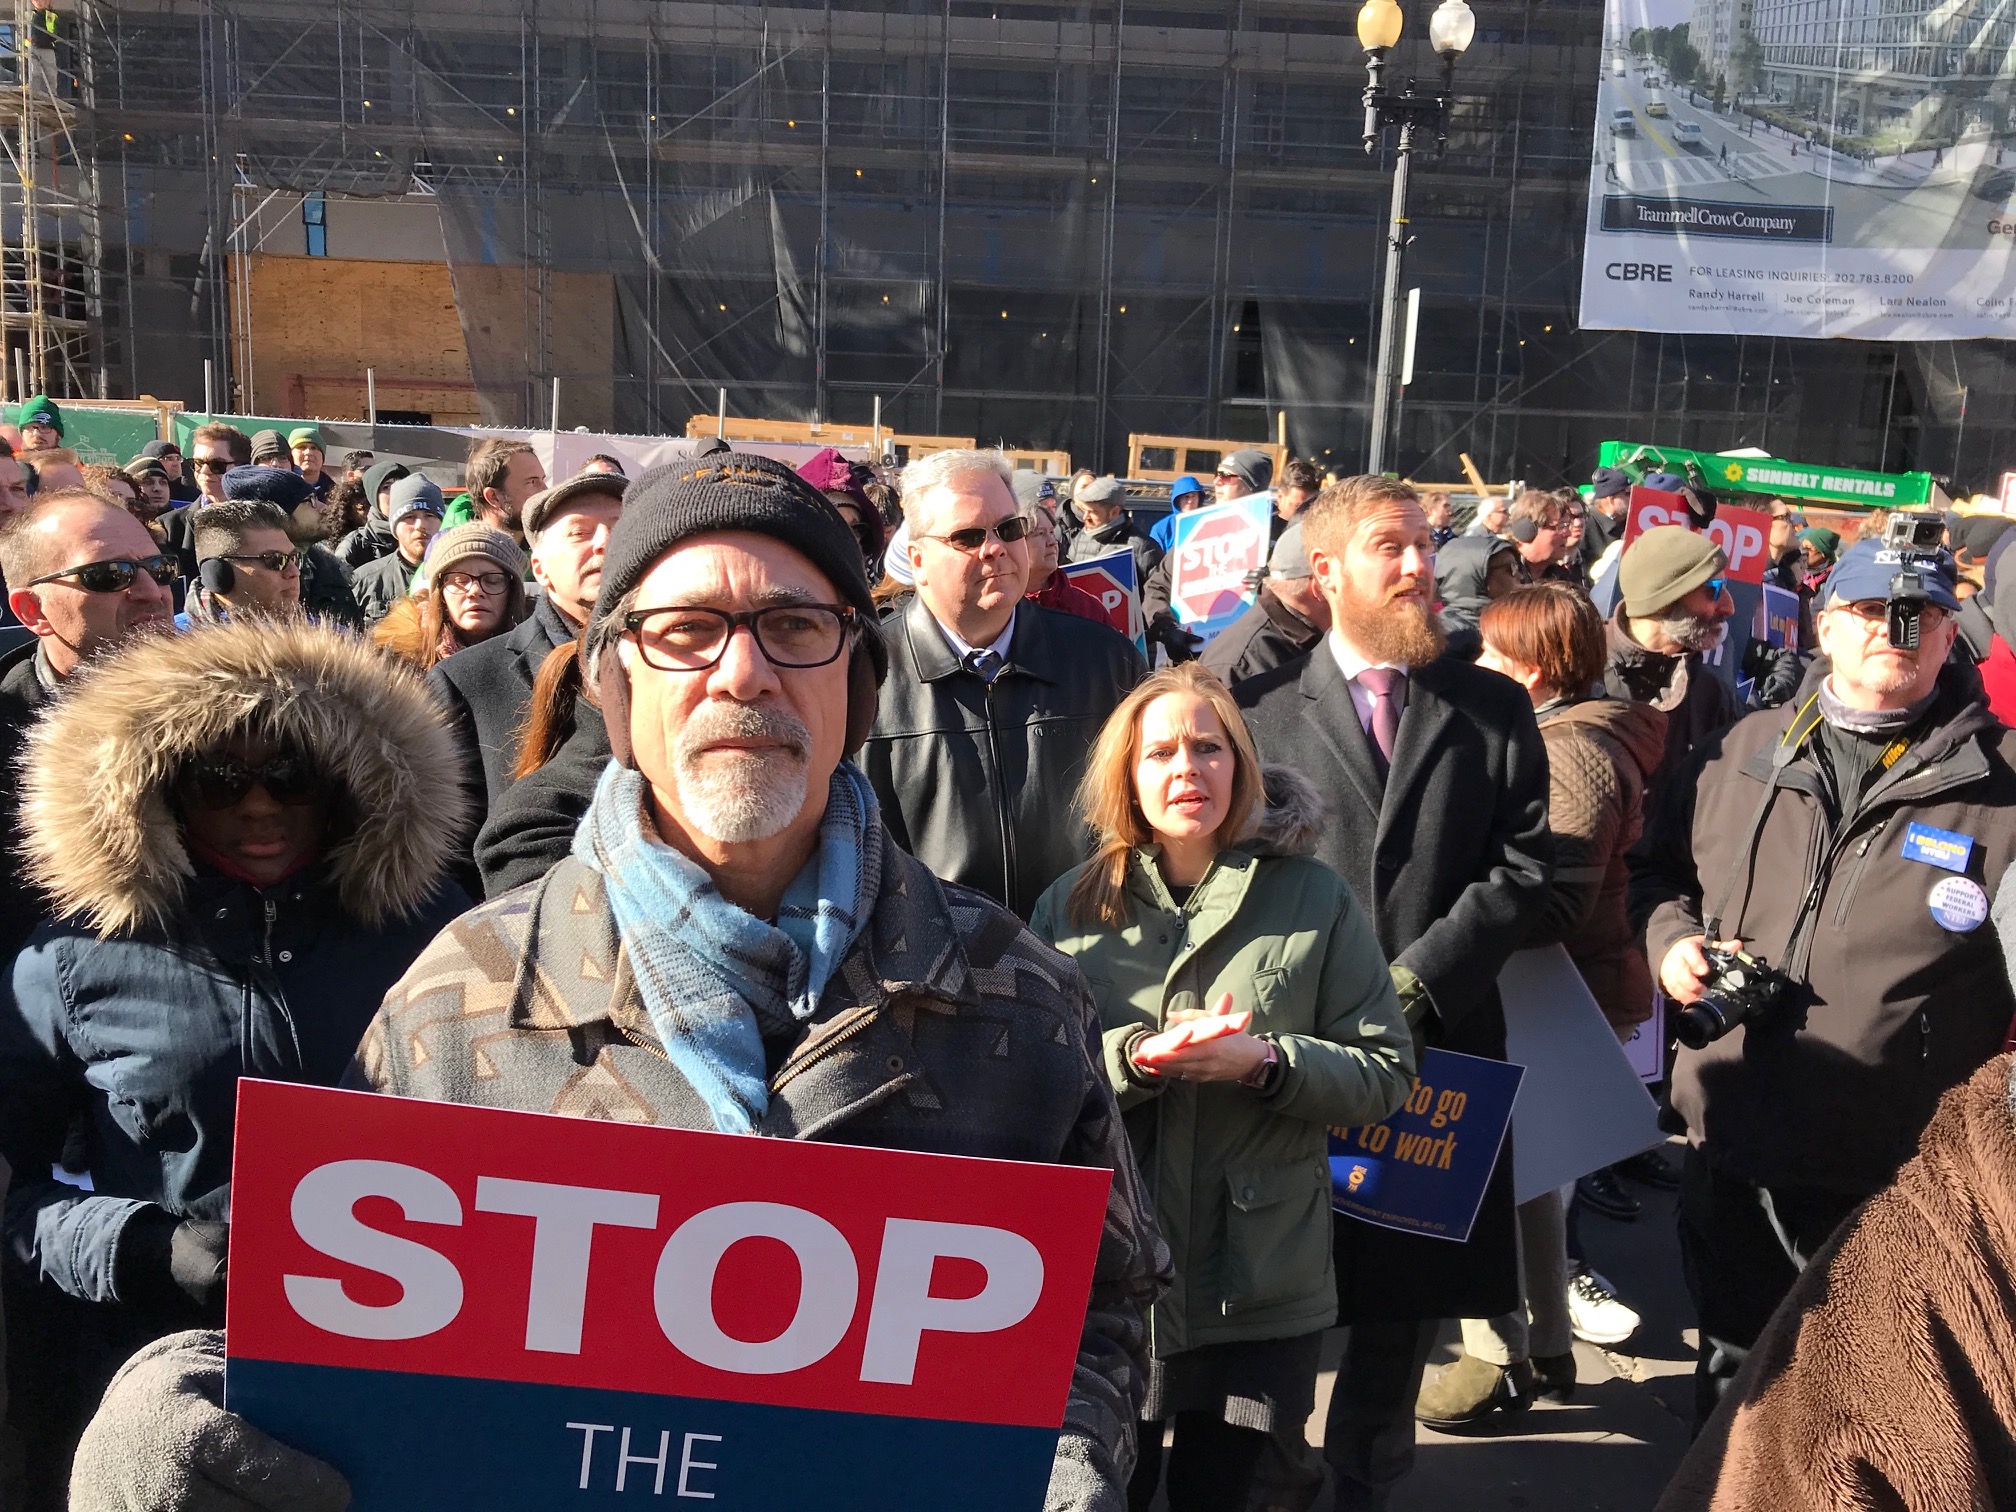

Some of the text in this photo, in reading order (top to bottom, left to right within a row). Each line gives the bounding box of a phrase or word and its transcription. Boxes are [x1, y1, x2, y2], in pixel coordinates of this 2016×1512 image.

[1987, 219, 2016, 236] Ge
[1605, 262, 1673, 282] CBRE
[1689, 266, 1712, 277] FOR
[1716, 267, 1764, 280] LEASING
[1834, 273, 1914, 284] 202.783.8200
[1689, 288, 1765, 302] Randy Harrell
[1784, 293, 1803, 303] Joe
[1906, 297, 1947, 307] Nealon
[1976, 297, 2005, 307] Colin
[1746, 467, 1896, 498] SUNBELT RENTALS
[1182, 529, 1259, 571] STOP
[1946, 886, 1979, 900] SUPPORT
[1942, 902, 1976, 917] WORKERS
[1945, 895, 1975, 909] FEDERAL
[1404, 1077, 1468, 1128] to go
[1358, 1122, 1390, 1153] to
[1394, 1131, 1458, 1170] work
[283, 1159, 1044, 1385] STOP
[566, 1421, 723, 1498] THE
